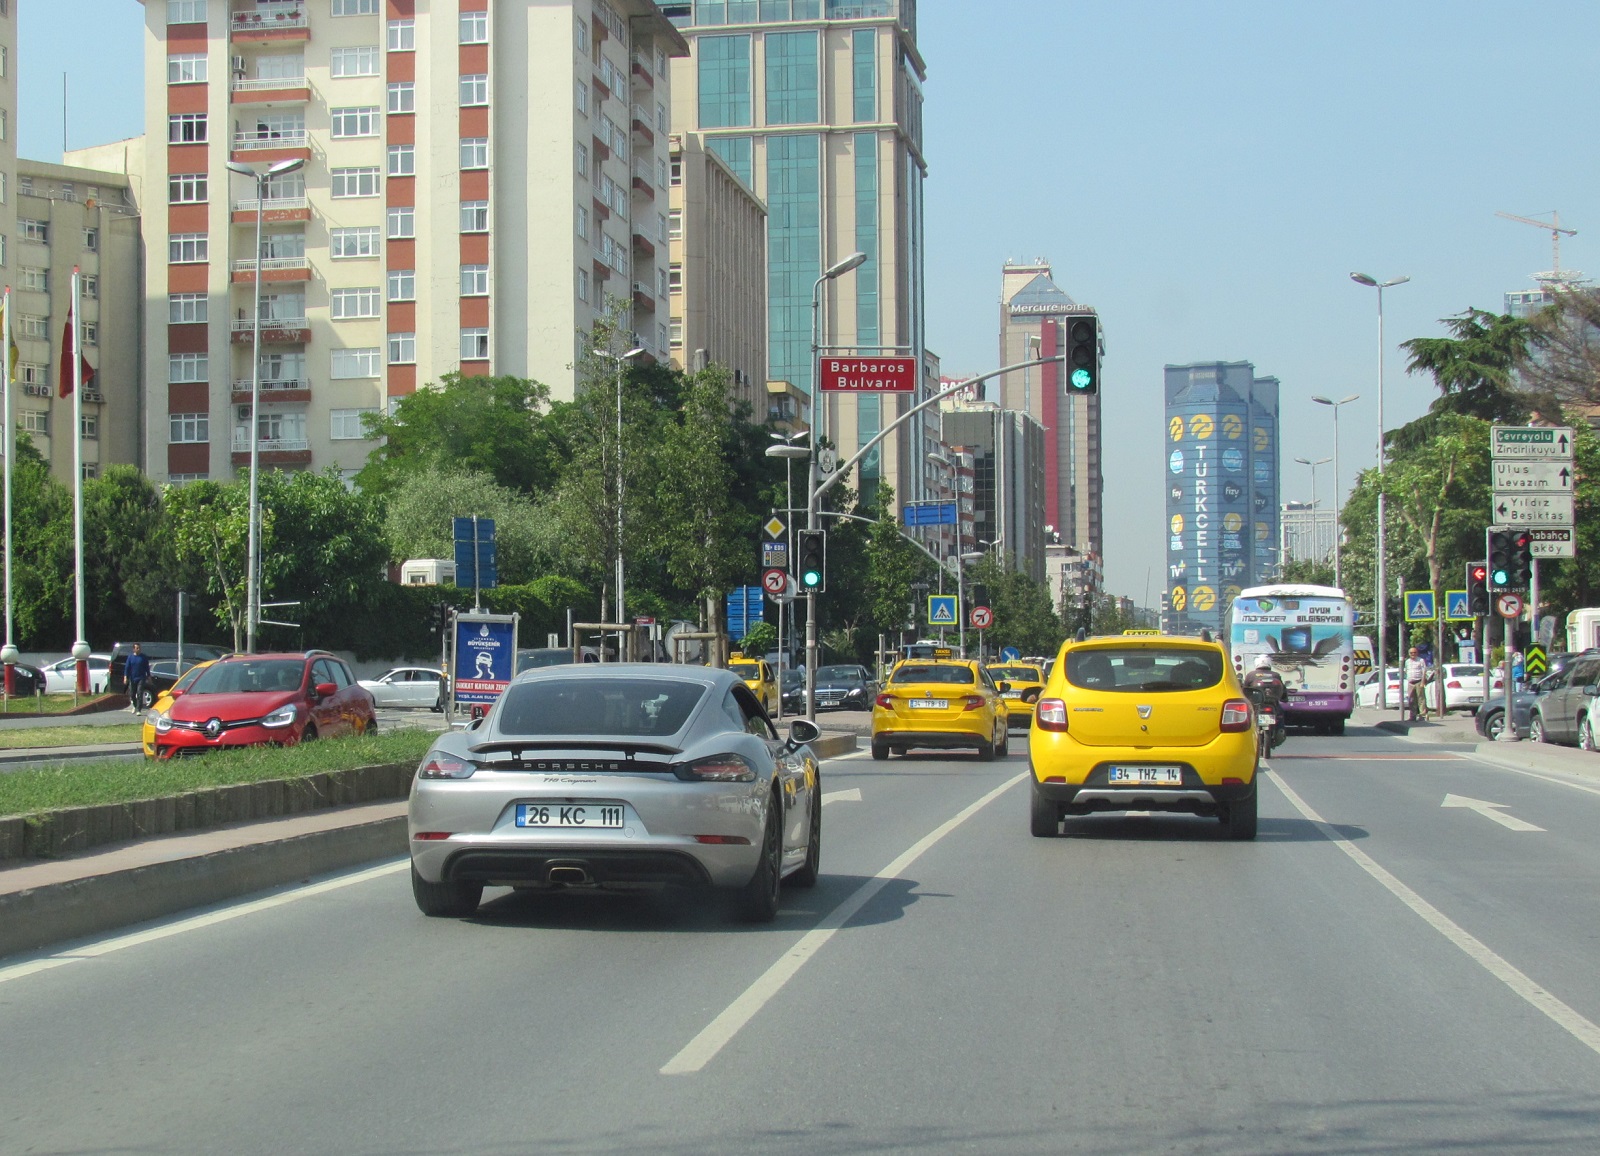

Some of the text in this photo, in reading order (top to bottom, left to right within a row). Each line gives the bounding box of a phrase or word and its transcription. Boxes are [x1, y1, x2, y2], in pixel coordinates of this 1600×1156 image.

[1011, 304, 1058, 312] Mercure
[831, 361, 904, 373] Barbaros
[838, 377, 897, 387] Bulvarı
[1497, 431, 1551, 442] Çevreyolu
[1497, 444, 1556, 455] Zincirlikuyu
[1498, 465, 1529, 474] Ulus
[1498, 478, 1548, 487] Levazım
[1225, 486, 1239, 498] fizy
[1511, 498, 1550, 507] Yıldız
[1195, 445, 1208, 582] TURKCELL
[1511, 510, 1563, 520] Beşiktaş
[1533, 544, 1562, 554] aköy
[1116, 769, 1177, 780] 34 THZ 14
[560, 777, 597, 785] Cayman
[528, 807, 620, 825] 26 KC 111
